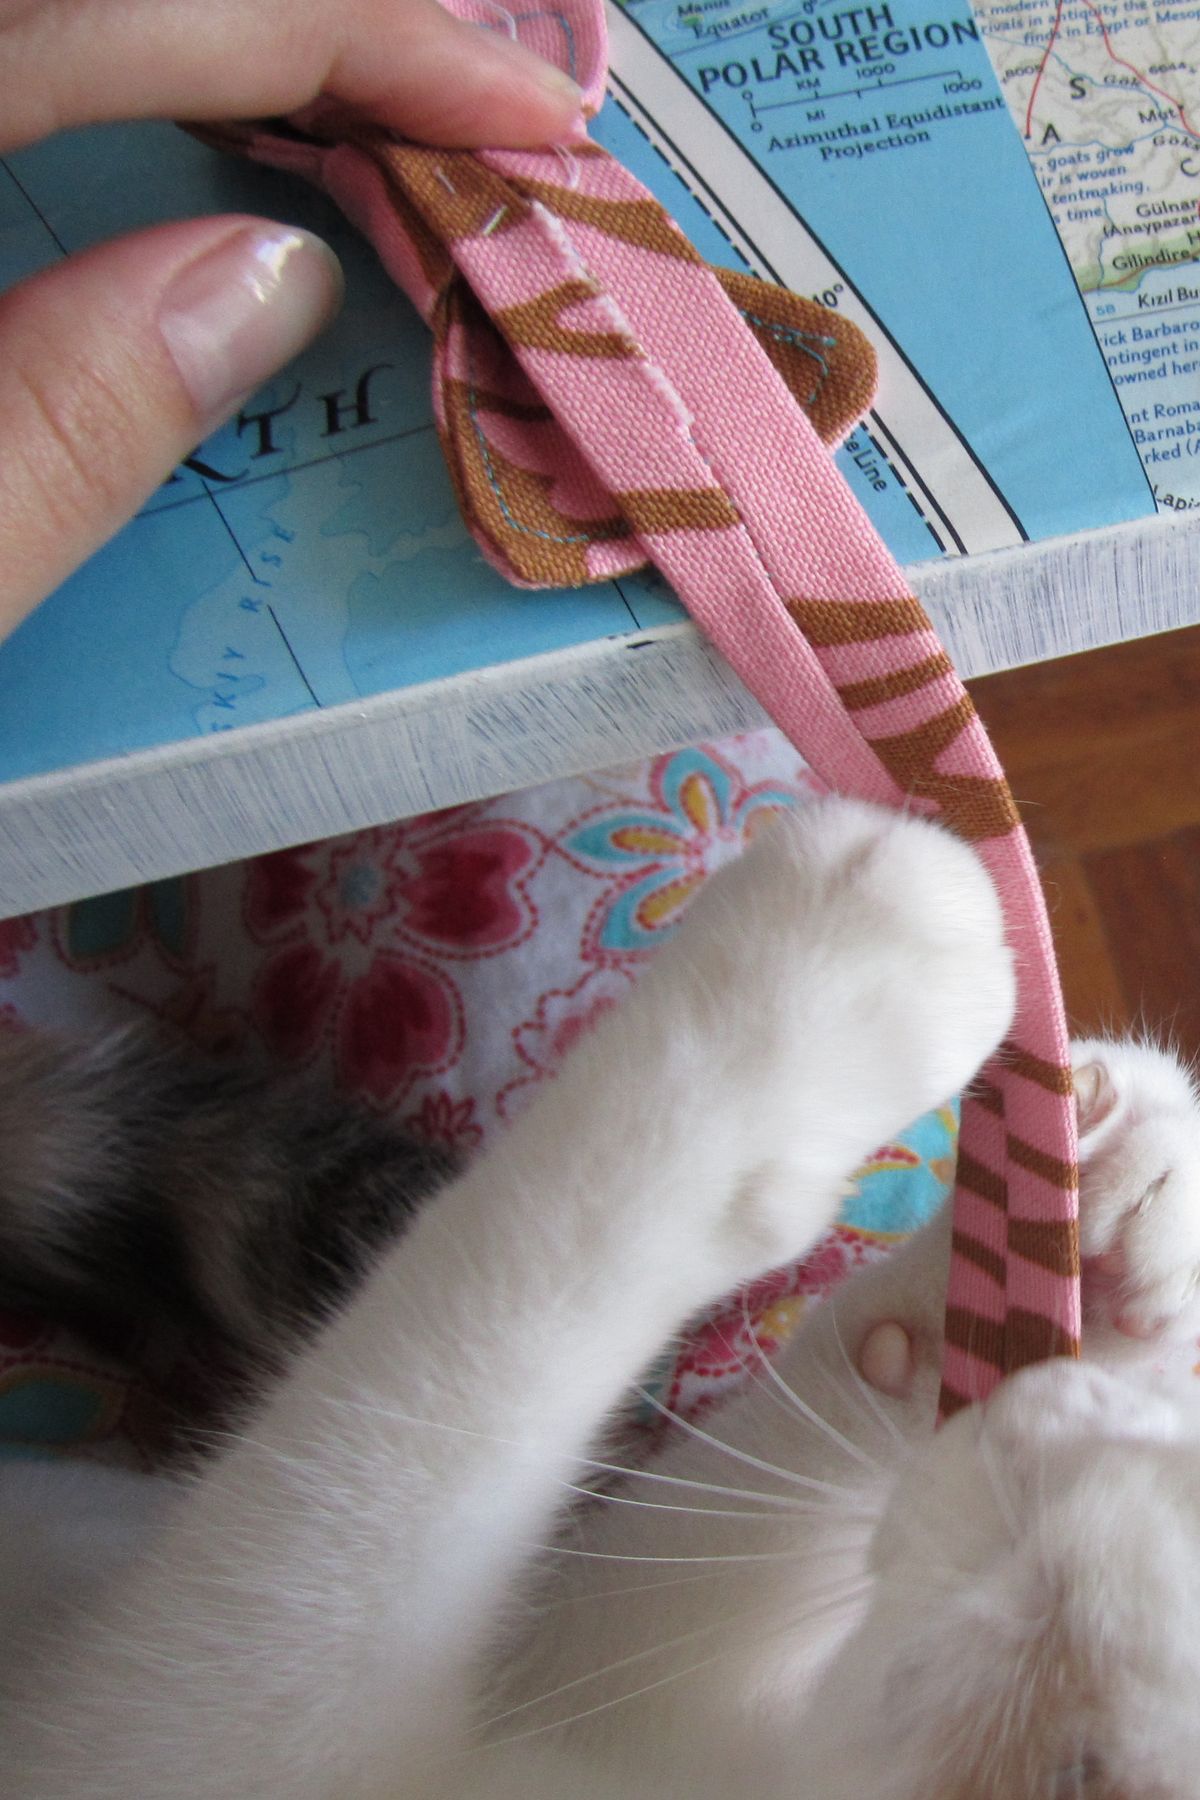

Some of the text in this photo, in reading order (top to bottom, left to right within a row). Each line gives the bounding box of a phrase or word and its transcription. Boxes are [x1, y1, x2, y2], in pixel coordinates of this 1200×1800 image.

[768, 4, 895, 50] SOUTH
[698, 18, 980, 93] POLAR REGION
[856, 62, 896, 79] 1000
[943, 79, 983, 95] 1000
[769, 96, 1006, 152] Azimuthal Equidistant
[820, 130, 931, 161] Projection
[1077, 165, 1127, 181] woven
[1112, 248, 1191, 272] Gilindire
